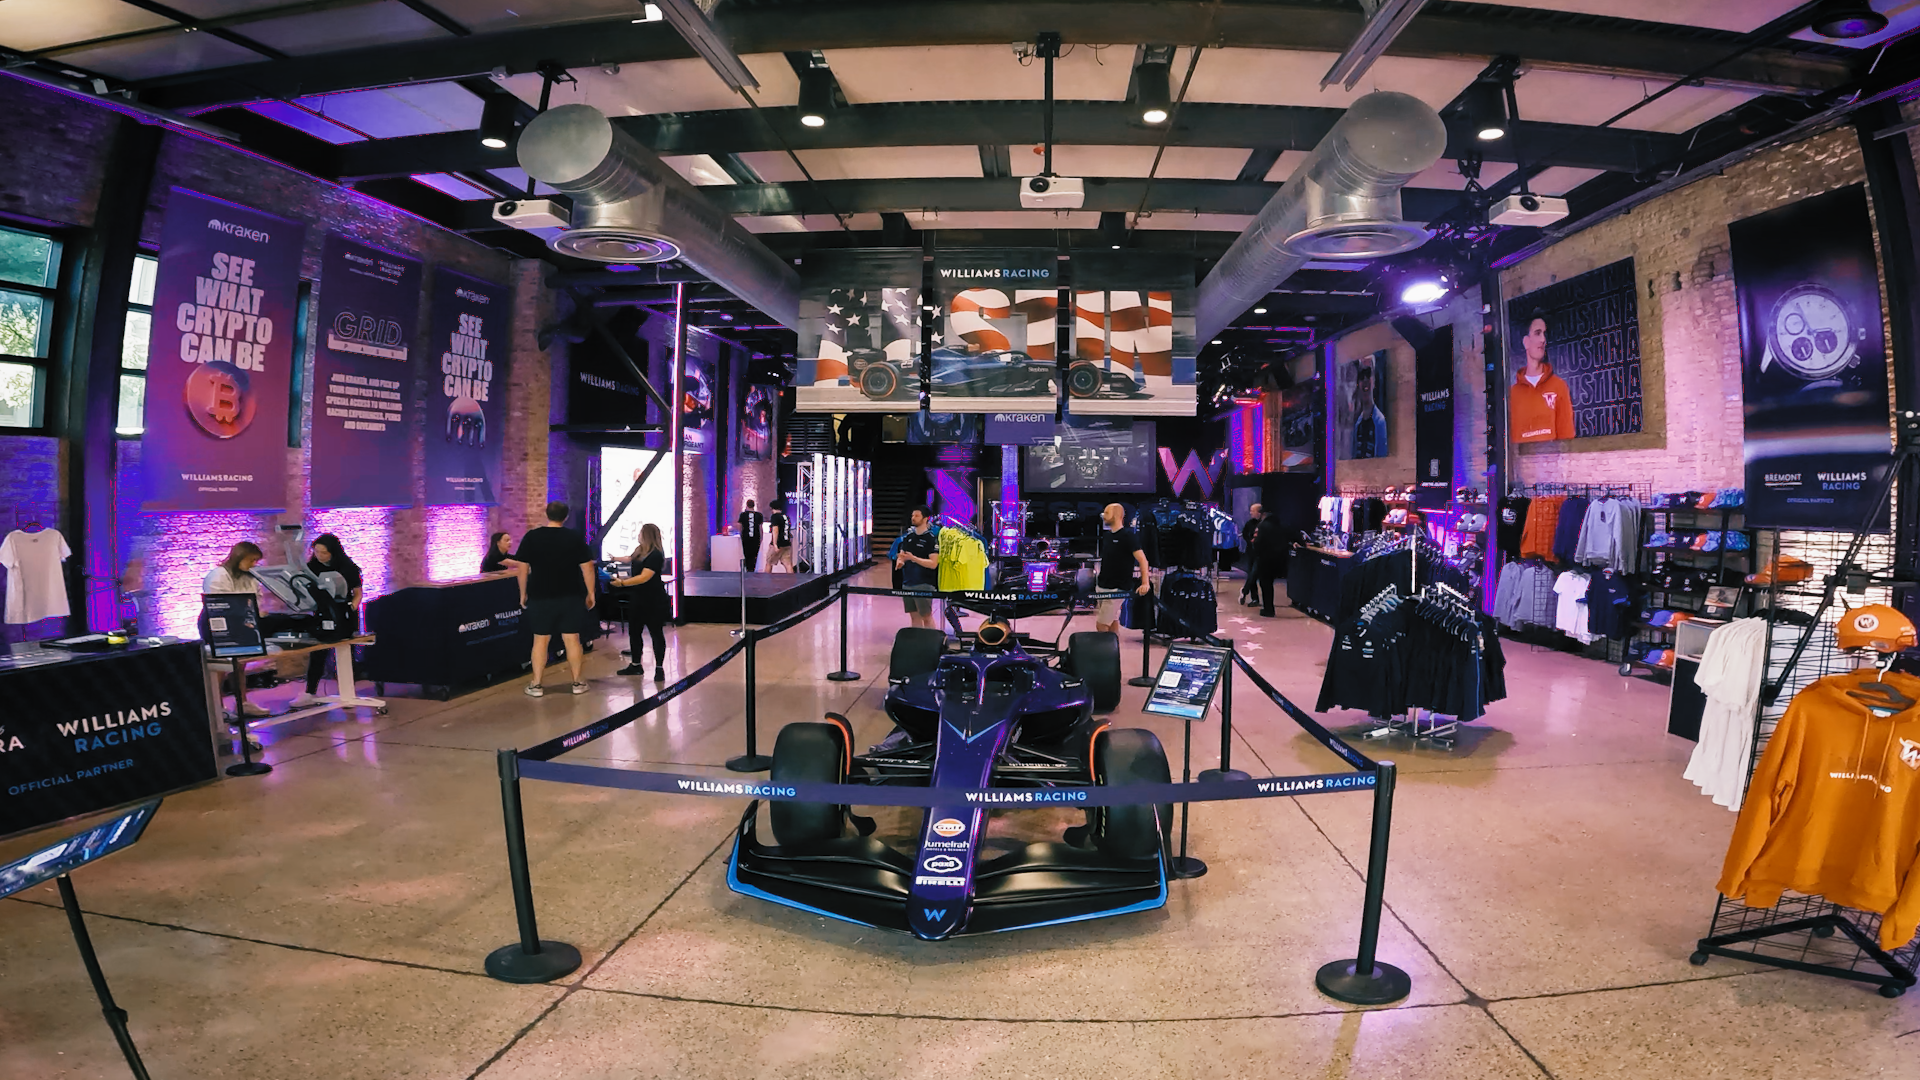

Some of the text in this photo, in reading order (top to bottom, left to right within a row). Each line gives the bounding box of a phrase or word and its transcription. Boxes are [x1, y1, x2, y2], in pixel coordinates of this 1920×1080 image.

[221, 221, 269, 243] kraken
[211, 252, 256, 286] SEE
[940, 268, 1050, 278] WILLIAMS RACING
[196, 275, 264, 315] WHAT
[176, 302, 273, 345] CRYPTO
[334, 311, 402, 347] GRID
[458, 313, 483, 338] SEE
[180, 333, 266, 372] CAN BE
[451, 332, 488, 360] WHAT
[442, 352, 493, 382] CRYPTO
[444, 374, 489, 402] CAN BE
[579, 371, 616, 391] WILLIAMS
[1567, 366, 1625, 407] USTIN
[1421, 387, 1450, 402] WILLIAMS
[1005, 413, 1046, 423] kraken
[1764, 473, 1802, 482] BREMONT
[1817, 472, 1867, 481] WILLIAMS
[1822, 482, 1860, 491] RACING
[964, 591, 1059, 601] WILLIAMS RACING
[494, 608, 522, 620] WILLIAMS
[56, 701, 172, 737] WILLIAMS
[74, 722, 162, 753] RACING
[562, 730, 591, 748] WILLIAMS
[8, 758, 134, 796] OFFICIAL PARTNER
[1257, 775, 1376, 792] WILLIAMS RACING
[677, 779, 796, 797] WILLIAMS RACING
[965, 791, 1087, 803] WILLIAMS RACING
[931, 860, 955, 869] pax8
[915, 875, 966, 887] PIRELLI
